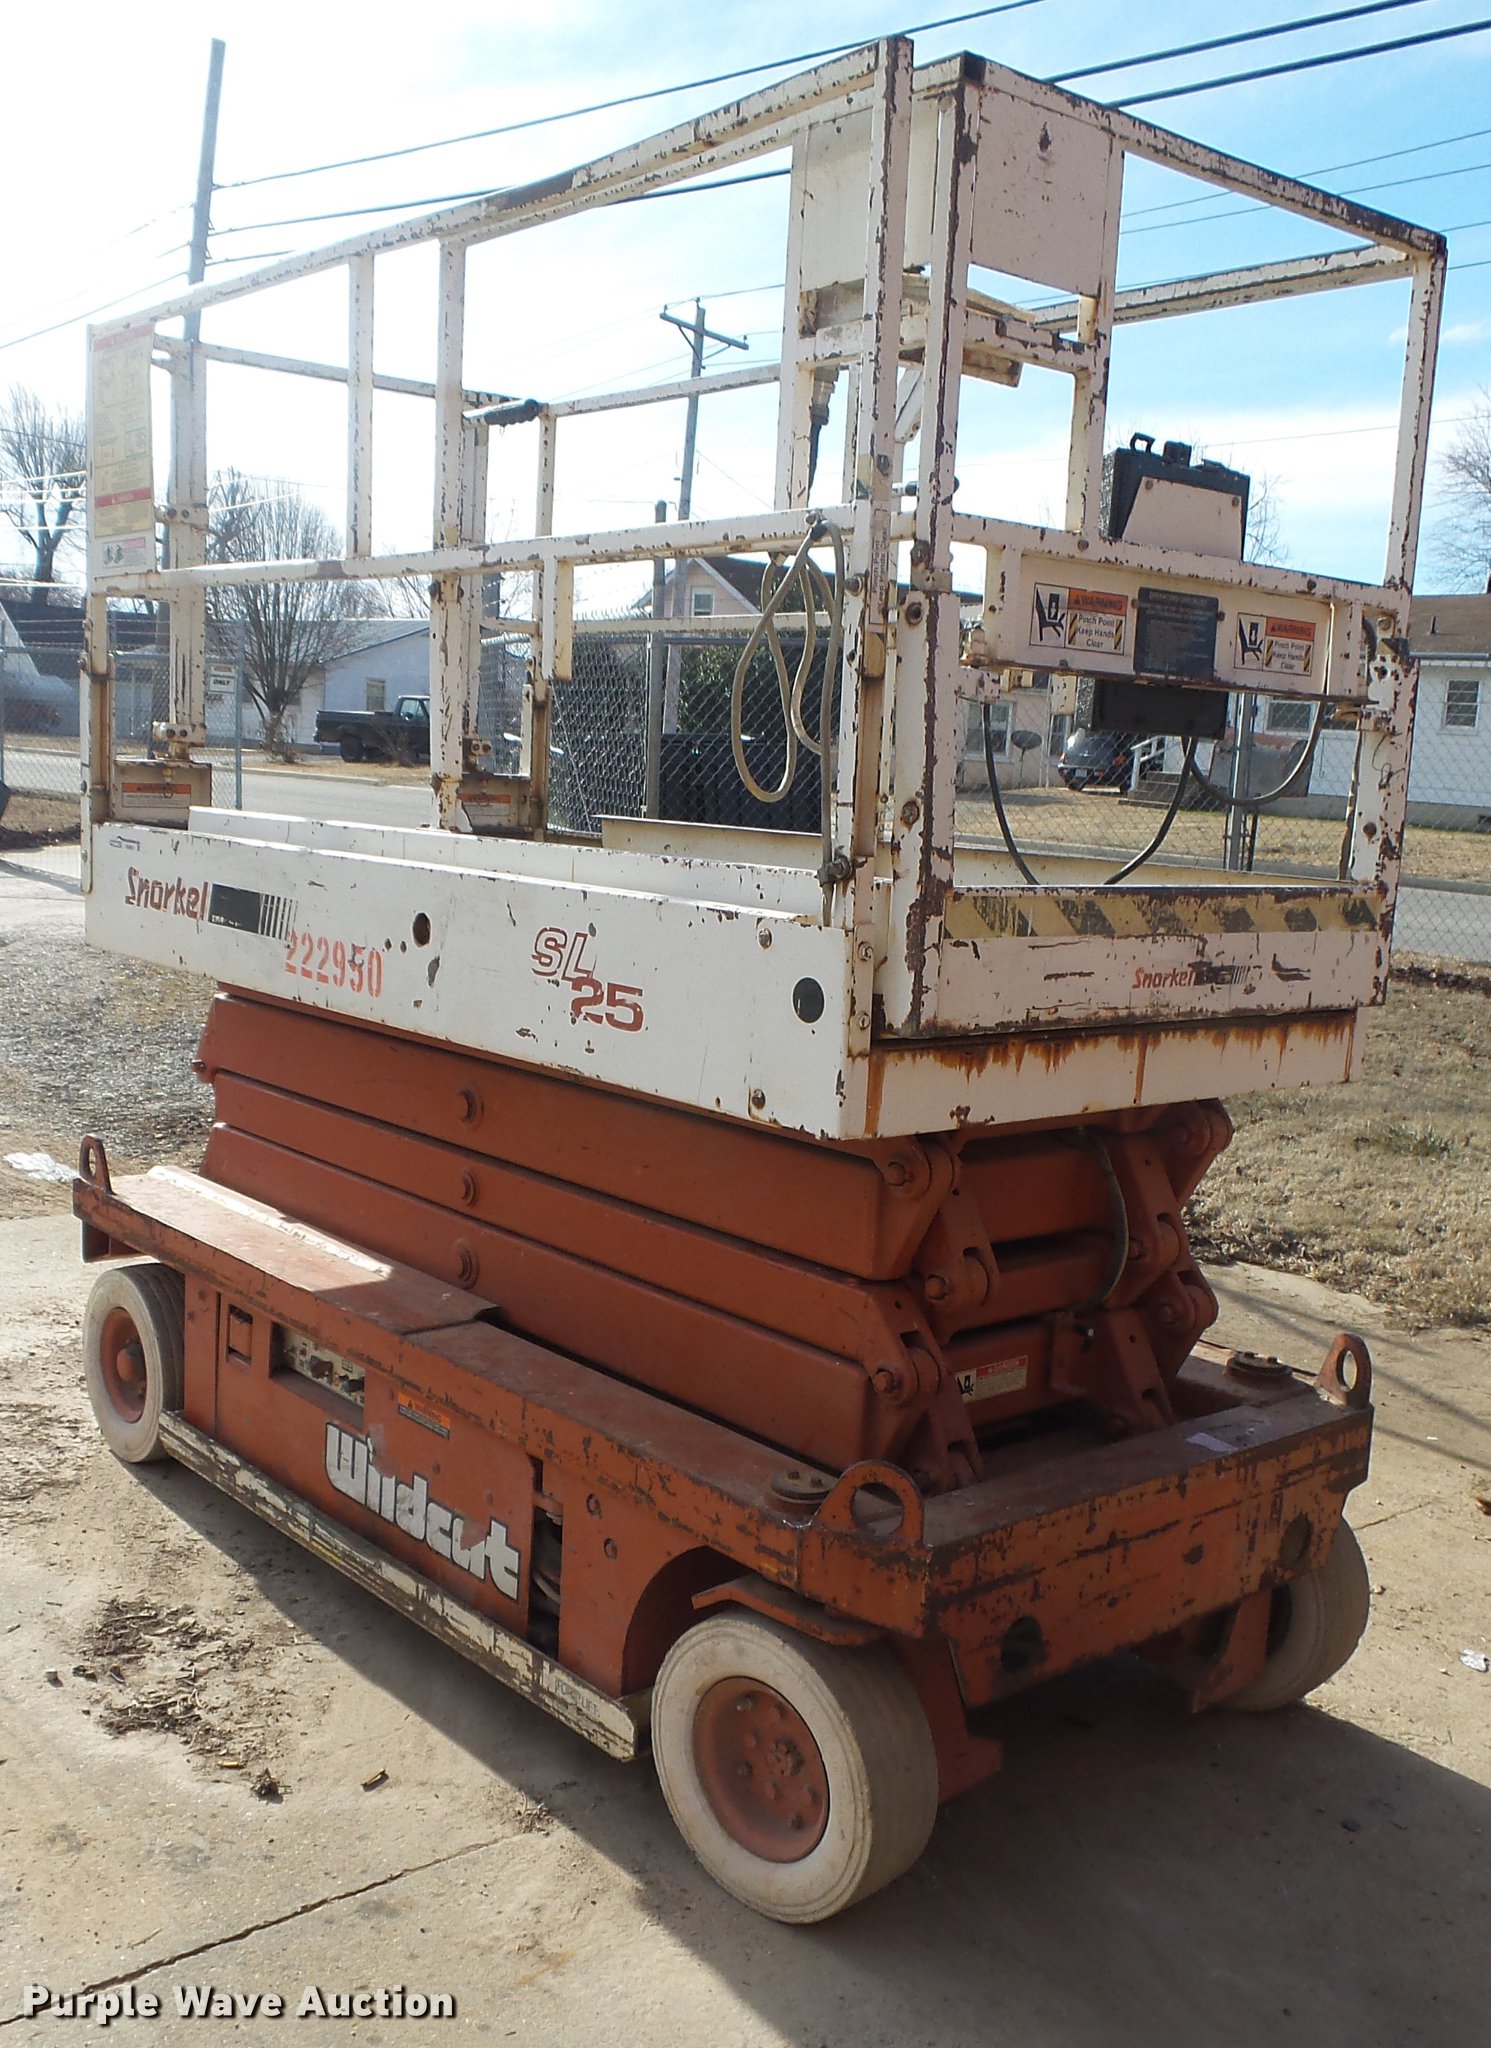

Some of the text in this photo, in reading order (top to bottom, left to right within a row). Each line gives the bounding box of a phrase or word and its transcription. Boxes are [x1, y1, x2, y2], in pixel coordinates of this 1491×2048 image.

[1080, 595, 1122, 611] WARNING
[1079, 614, 1115, 627] Pinch Point
[1077, 626, 1115, 638] Keep Hands
[1275, 623, 1312, 637] WARNING
[1086, 639, 1104, 648] Clear
[1275, 640, 1305, 650] Pinch Point
[1273, 651, 1287, 660] Keep
[125, 866, 209, 922] Snorkel
[531, 927, 593, 982] SL
[285, 928, 384, 998] 222950
[1132, 966, 1196, 989] Snorkel
[571, 977, 644, 1032] 25
